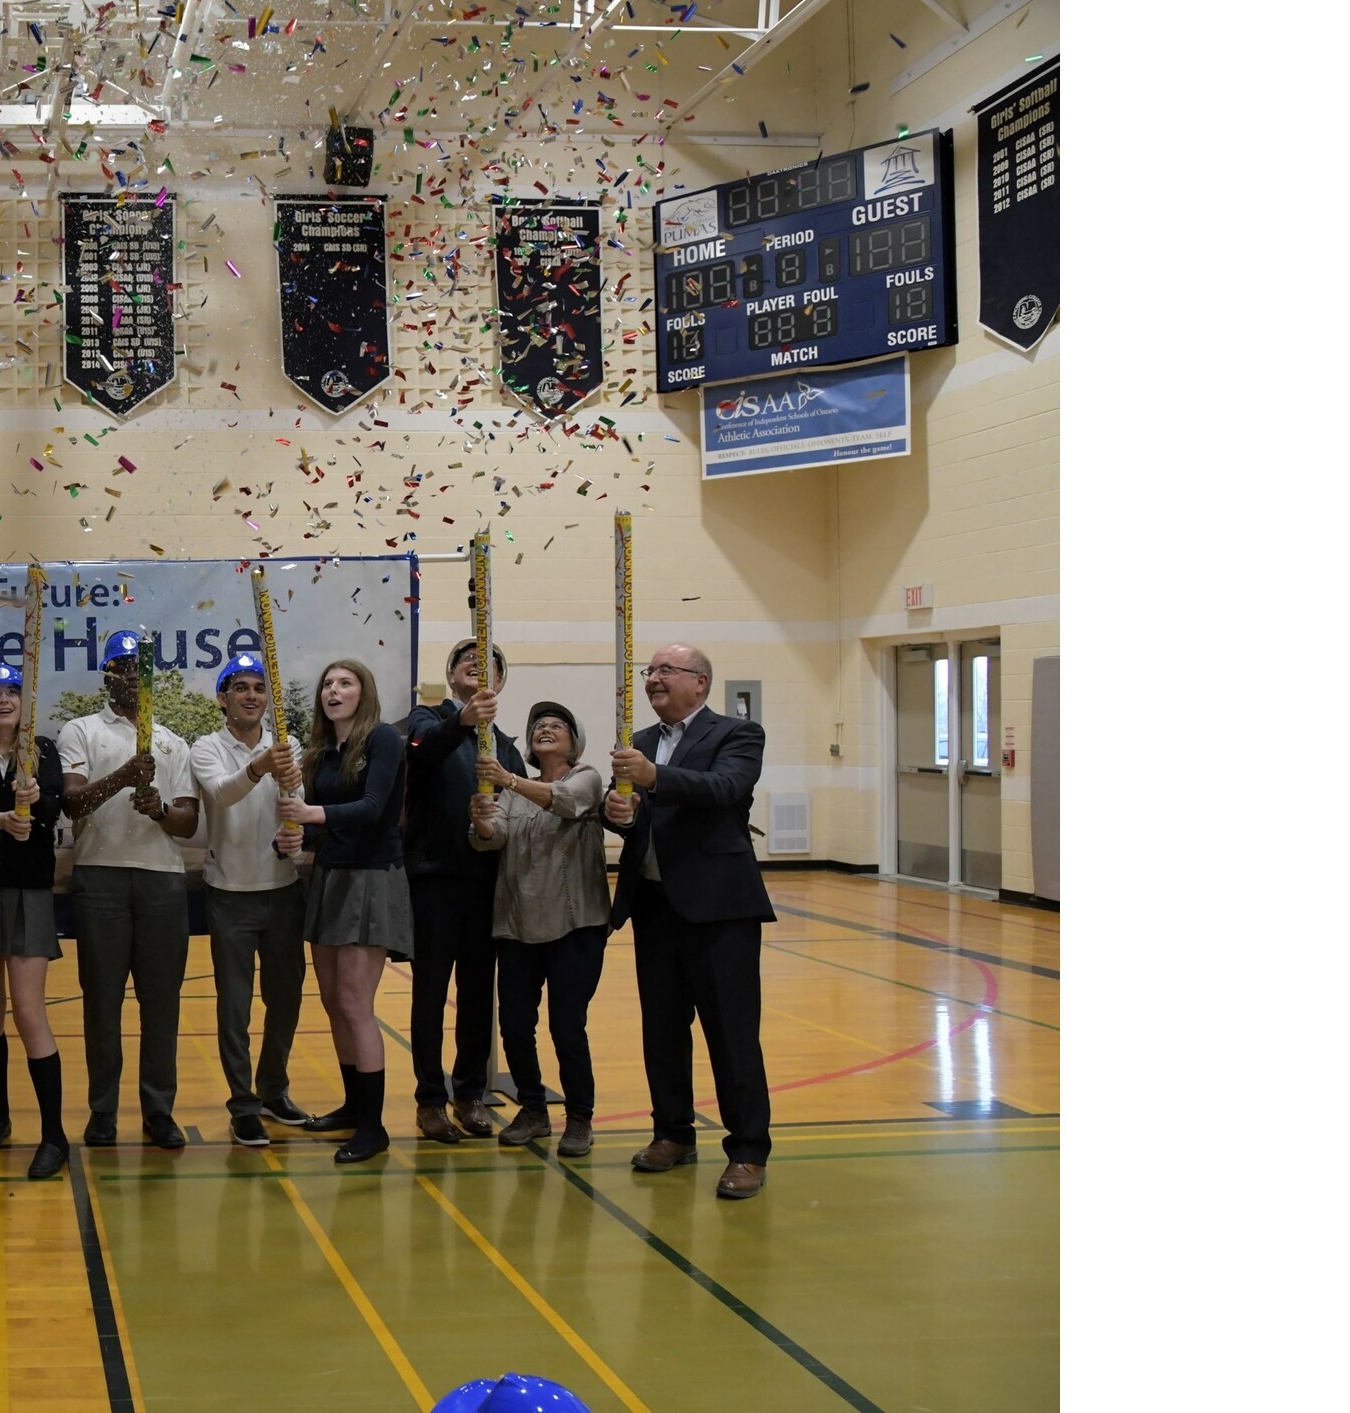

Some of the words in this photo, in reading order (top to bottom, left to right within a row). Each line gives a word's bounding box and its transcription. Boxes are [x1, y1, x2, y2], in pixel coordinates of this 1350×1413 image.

[991, 102, 1016, 129] Girls'
[1019, 77, 1057, 112] Softball
[998, 101, 1050, 142] Champions
[1015, 132, 1035, 151] CISAA
[1039, 121, 1054, 138] (SR)
[1016, 145, 1036, 163] CISAA
[1039, 134, 1054, 151] (SR)
[1016, 158, 1036, 176] CISAA
[1040, 148, 1054, 164] (SR)
[993, 185, 1009, 201] 2011
[1016, 171, 1037, 189] CISAA
[1040, 161, 1054, 177] (SR)
[994, 197, 1010, 214] 2012
[1017, 184, 1038, 202] CISAA
[1041, 174, 1055, 191] (SR)
[294, 209, 322, 223] Girls'
[327, 211, 365, 223] Soccer
[851, 191, 924, 227] GUEST
[301, 225, 361, 237] Champions
[766, 229, 815, 251] PERIOD
[673, 238, 727, 268] HOME
[885, 266, 935, 289] FOULS
[746, 294, 795, 316] PLAYER
[803, 286, 839, 305] FOUL
[666, 313, 706, 332] FOULS
[887, 325, 938, 347] SCORE
[770, 346, 819, 367] MATCH
[667, 365, 706, 384] SCORE
[747, 419, 754, 428] of
[754, 414, 787, 427] Independent
[788, 411, 809, 422] Schools
[810, 409, 816, 418] of
[816, 406, 839, 416] Ontario
[717, 430, 751, 444] Athletic
[752, 424, 800, 439] Association
[833, 447, 859, 458] Honour
[860, 446, 871, 455] the
[872, 444, 892, 455] game!
[475, 554, 486, 609] CANNON
[906, 586, 923, 607] EXIT
[259, 590, 277, 646] CANNON
[53, 616, 264, 671] Huse
[476, 609, 488, 672] CONFETTI
[266, 646, 284, 707] CONFETTI
